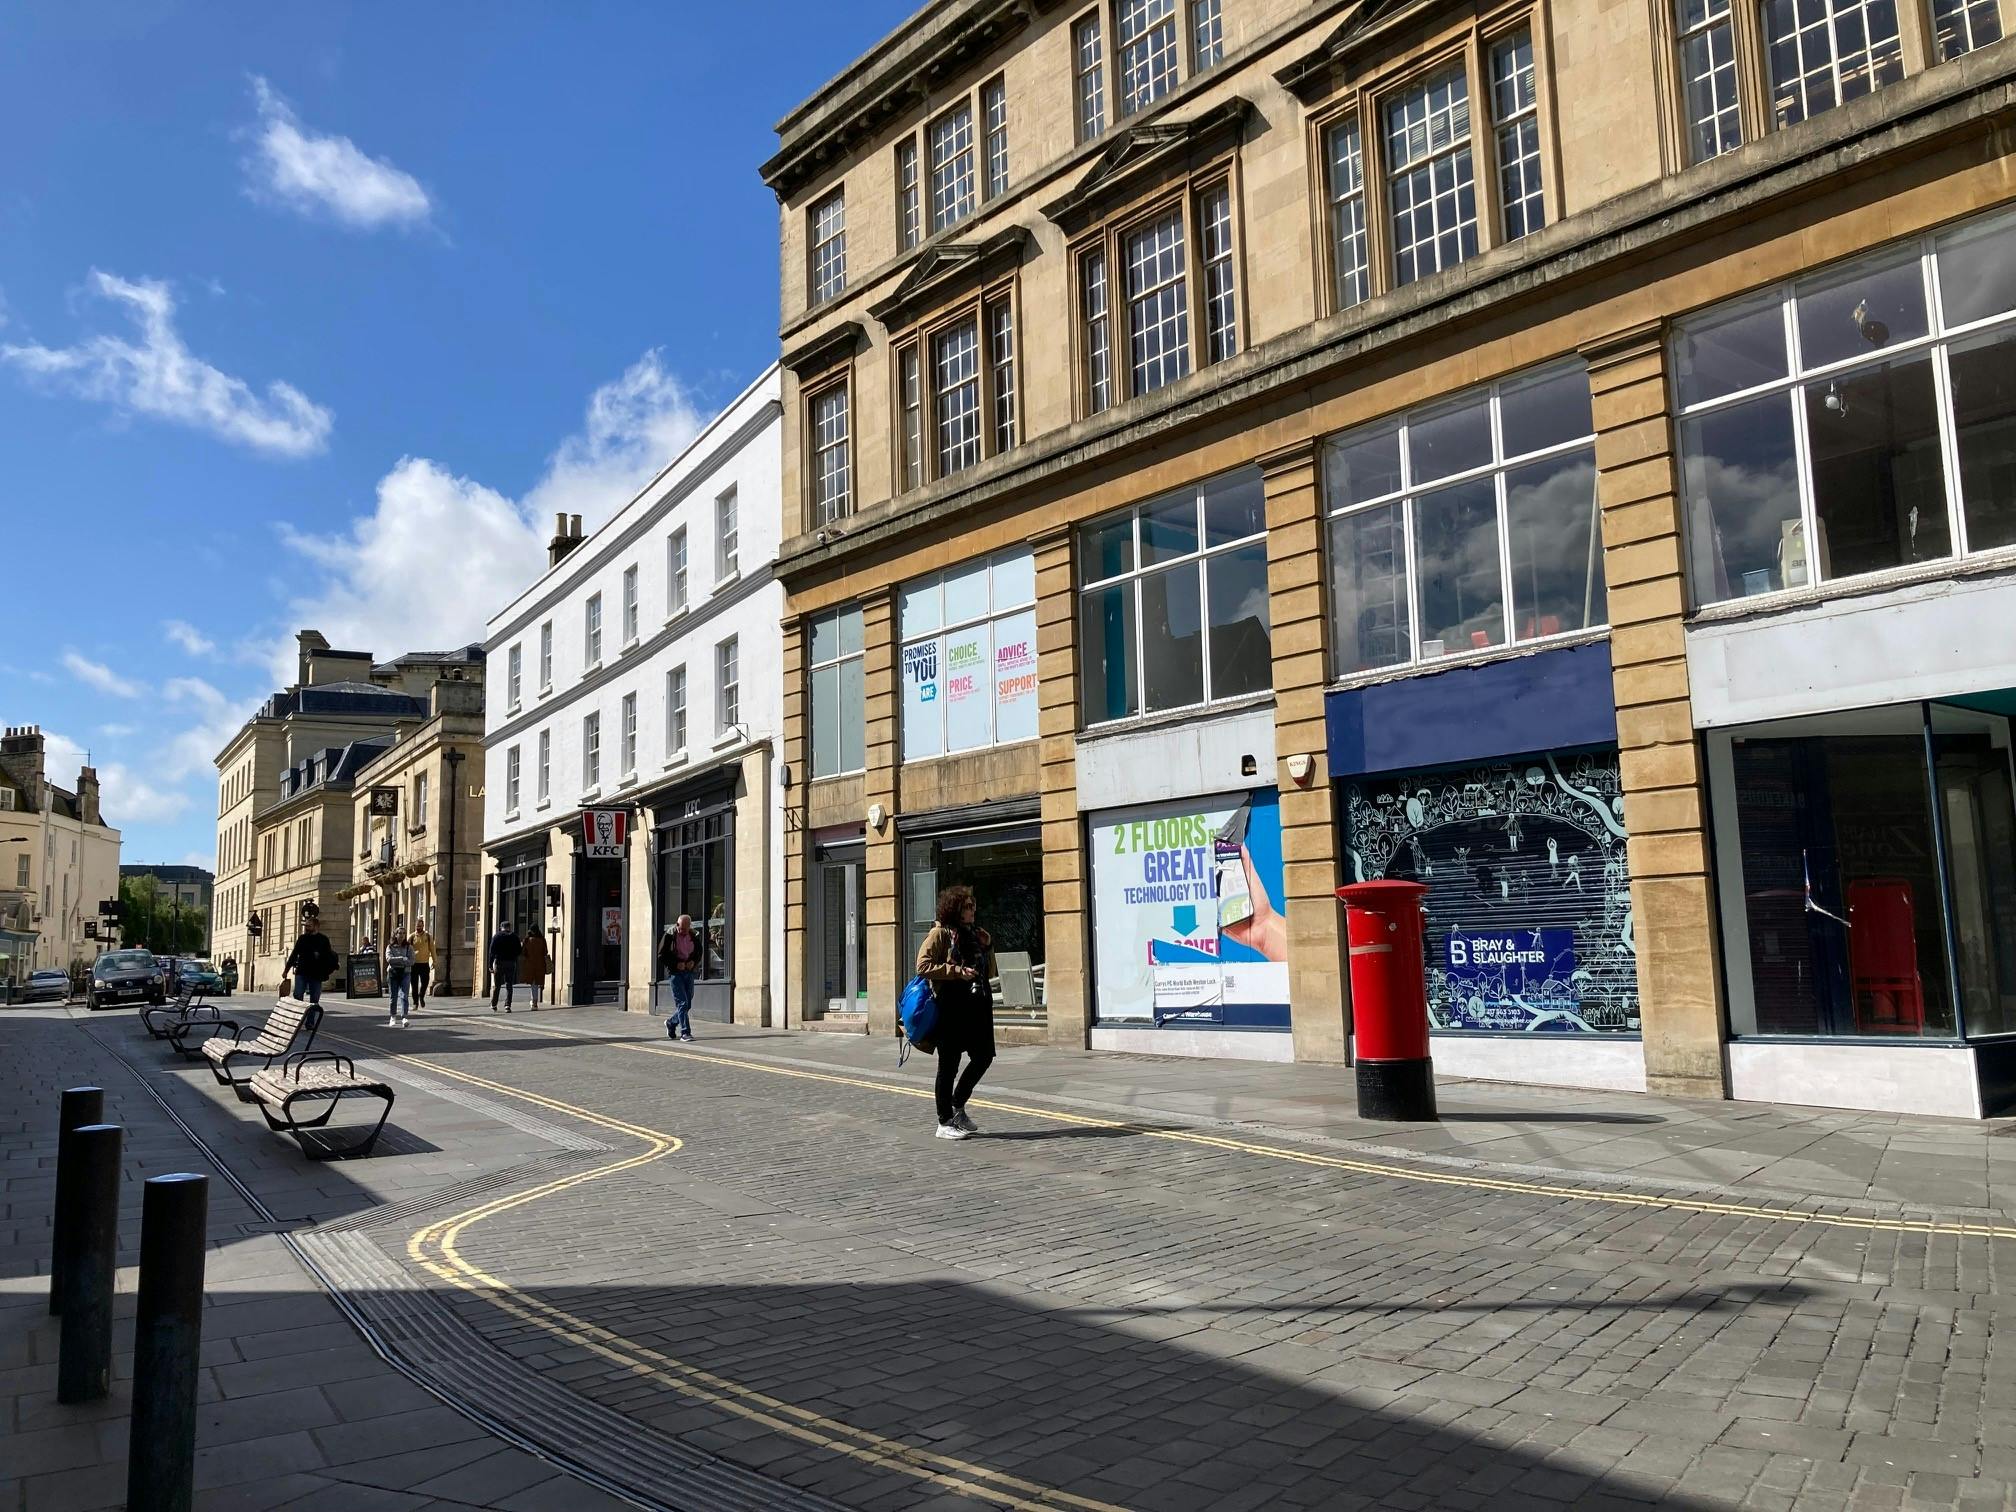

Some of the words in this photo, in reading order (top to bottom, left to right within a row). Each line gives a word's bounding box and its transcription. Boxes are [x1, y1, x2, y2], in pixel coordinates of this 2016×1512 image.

[904, 641, 936, 662] PROMISES
[949, 642, 978, 662] CHOICE
[998, 642, 1027, 662] ADVICE
[905, 661, 913, 675] TO
[913, 655, 936, 683] YOU
[949, 675, 973, 694] PRICE
[999, 673, 1036, 695] SUPPORT
[1114, 824, 1126, 855] 2
[1132, 815, 1206, 853] FLOORS
[592, 845, 619, 856] KFC
[1144, 847, 1206, 883] GREAT
[1124, 884, 1191, 904] TECHNOLOGY
[1193, 882, 1207, 900] TO
[1472, 939, 1503, 952] BRAY
[1506, 939, 1515, 951] &
[1472, 951, 1545, 964] SLAUGHTER
